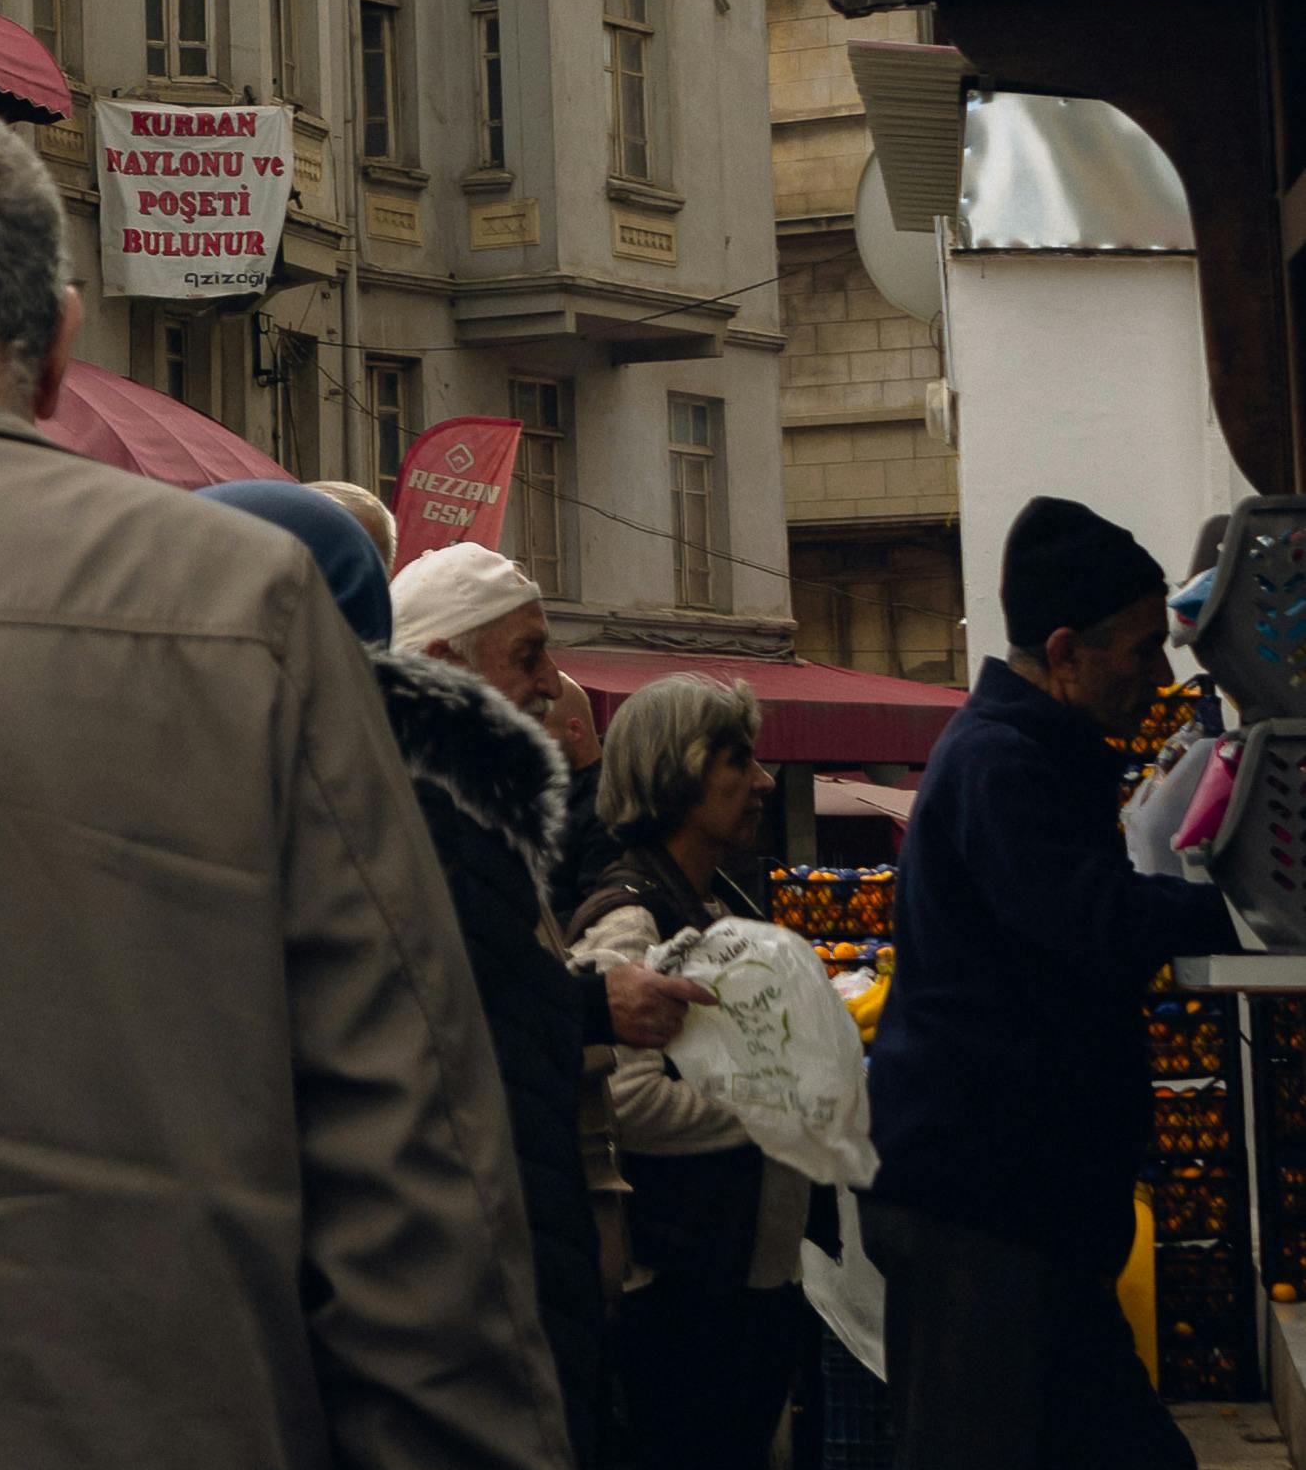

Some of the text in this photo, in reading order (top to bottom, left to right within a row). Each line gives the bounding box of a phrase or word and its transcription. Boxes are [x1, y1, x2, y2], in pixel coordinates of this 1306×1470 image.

[131, 111, 258, 138] KURBAN
[106, 147, 285, 177] NAYLONU ve
[138, 184, 251, 224] POŞETİ
[122, 229, 267, 256] BULUNUR
[184, 270, 266, 288] azizoğl
[408, 468, 501, 504] REZZAN
[422, 500, 477, 527] GSM
